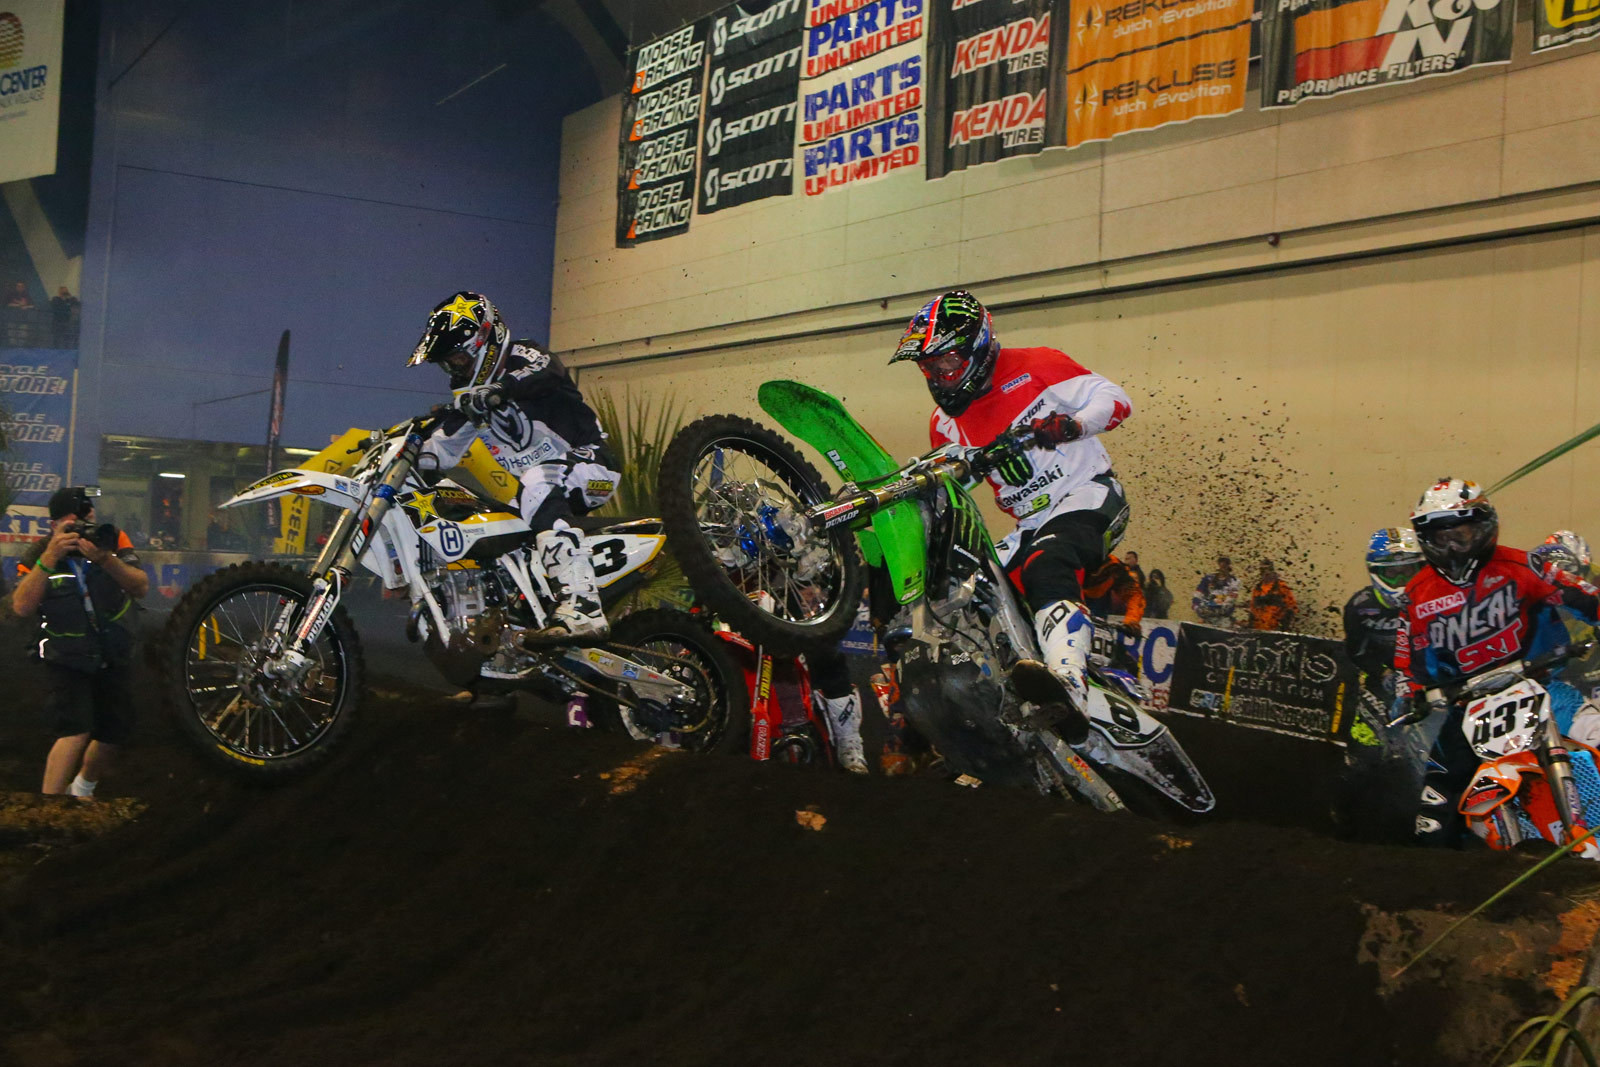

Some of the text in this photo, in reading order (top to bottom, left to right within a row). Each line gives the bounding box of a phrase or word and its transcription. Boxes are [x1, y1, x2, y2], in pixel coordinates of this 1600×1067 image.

[728, 0, 801, 41] SCOTT
[807, 0, 922, 57] PARTS
[807, 16, 923, 77] UNLIMITED
[950, 10, 1051, 79] KENDA
[1387, 53, 1456, 79] FILTERS
[0, 64, 47, 96] CENTER
[726, 46, 802, 91] SCOTT
[804, 55, 921, 121] PARTS
[1102, 59, 1235, 106] REKLUSE
[722, 101, 798, 142] SCOTT
[949, 88, 1047, 149] KENDA
[804, 112, 920, 177] PARTS
[719, 158, 794, 191] SCOTT
[804, 145, 920, 196] ULIMITED
[635, 181, 685, 215] OOSE
[1017, 398, 1047, 425] THOR
[1000, 464, 1064, 508] awasaki
[825, 510, 860, 529] DUNLOP
[593, 538, 628, 577] 3
[306, 593, 335, 644] DUNLOP
[1417, 592, 1466, 618] KENDA
